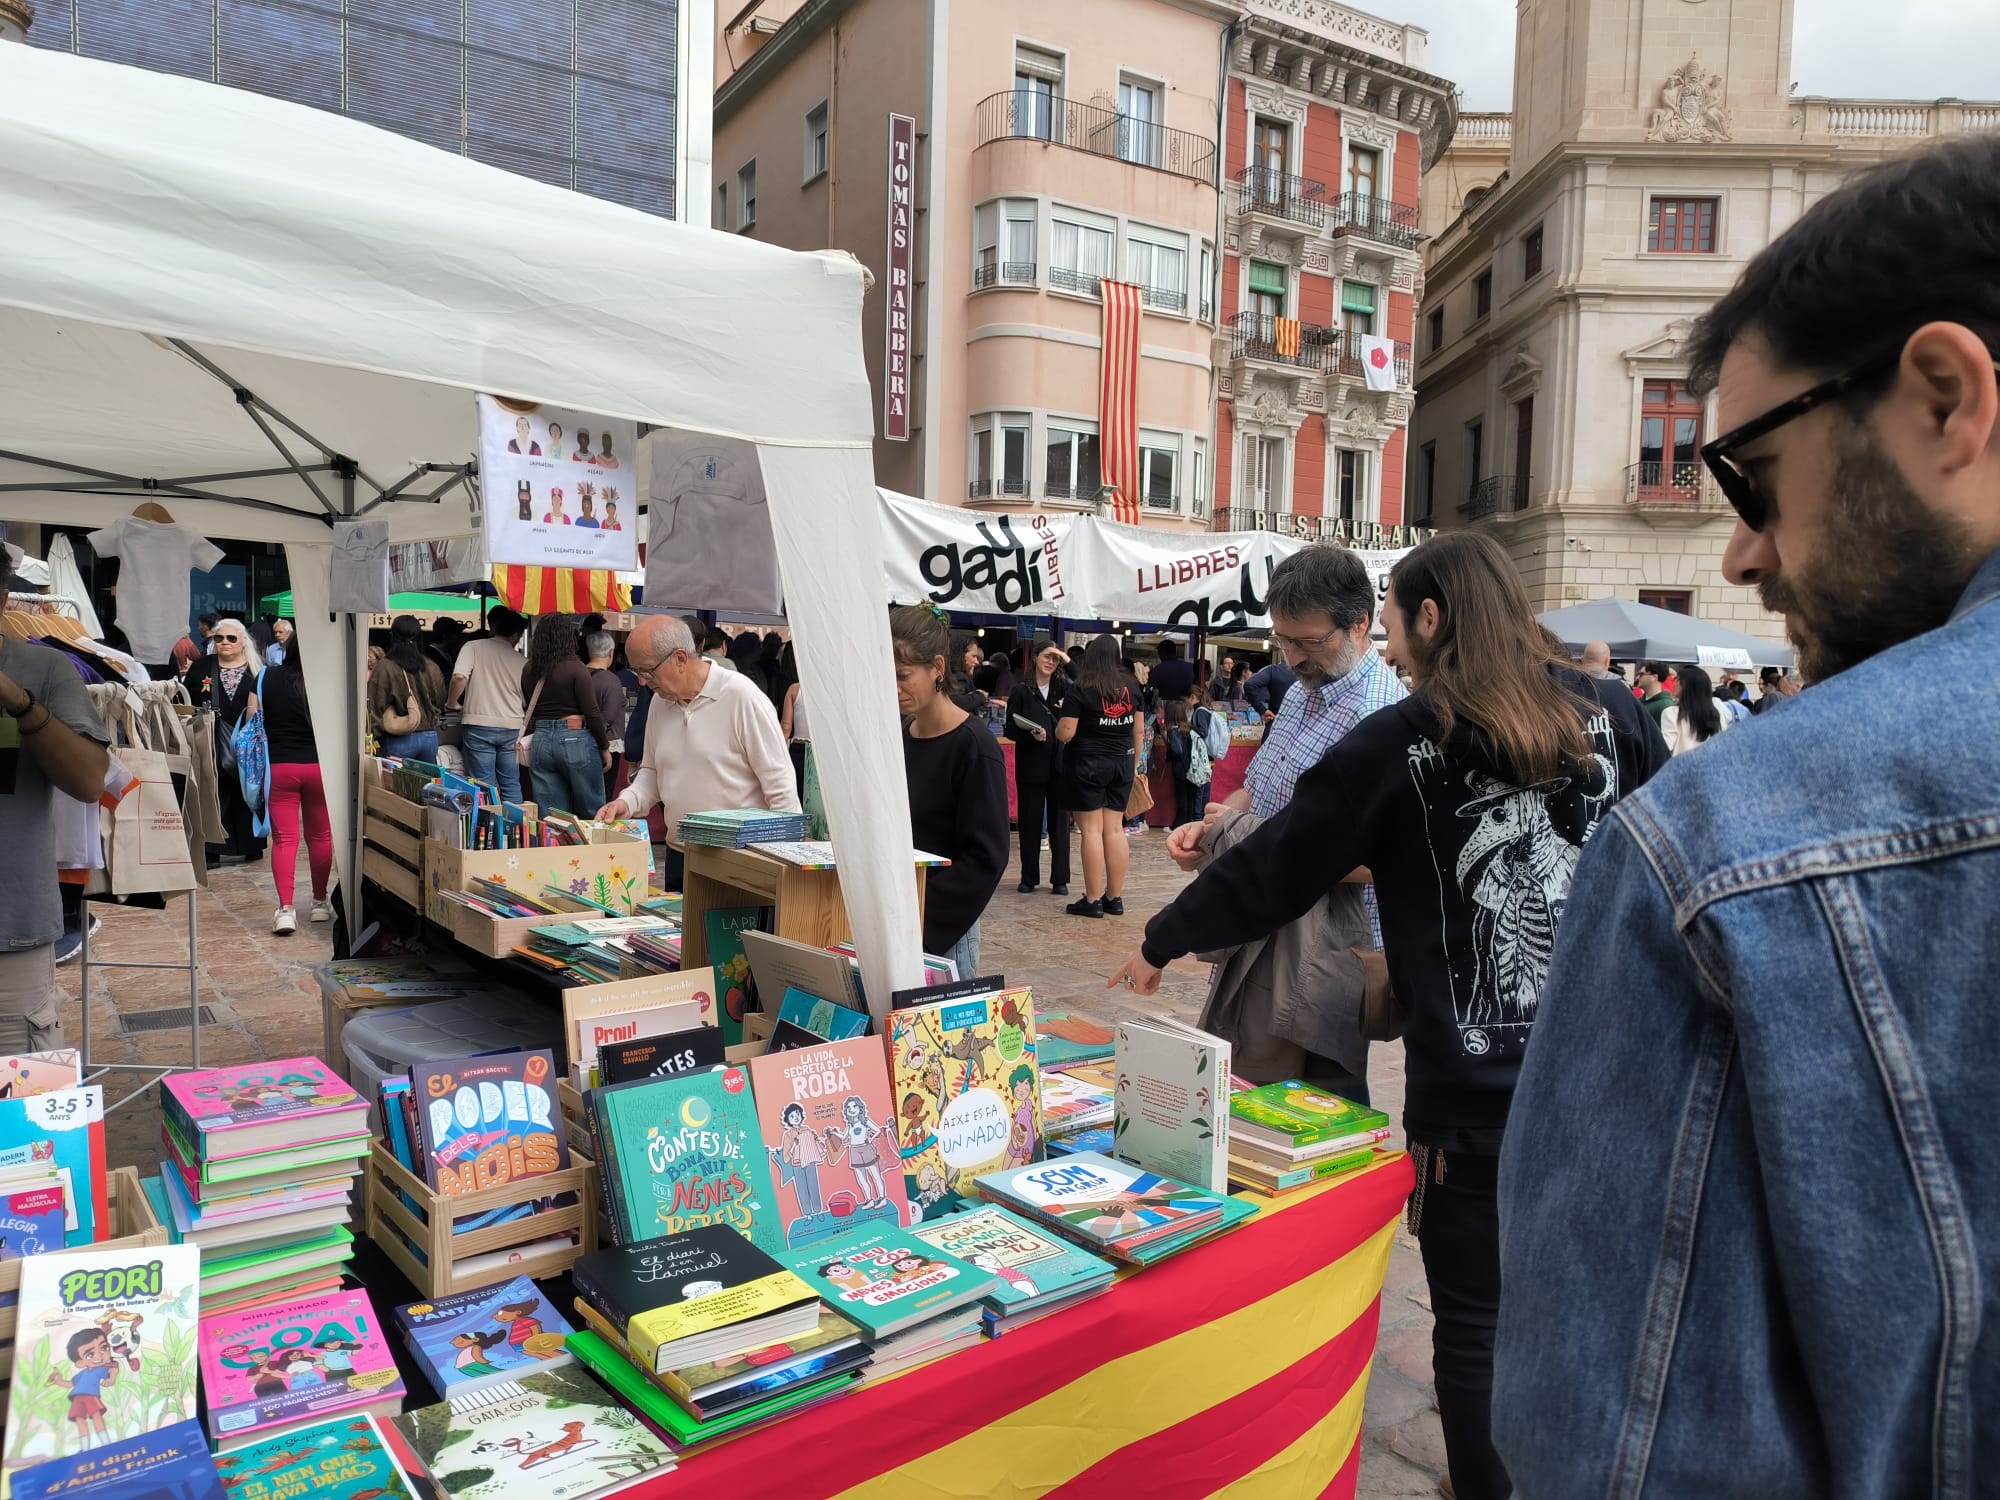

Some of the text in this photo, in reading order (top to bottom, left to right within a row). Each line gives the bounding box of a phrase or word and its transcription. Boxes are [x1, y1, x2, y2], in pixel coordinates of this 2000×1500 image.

[1253, 511, 1439, 545] RESTAURANT
[1032, 515, 1066, 600] LLIBRES
[1137, 545, 1240, 594] LLIBRES
[1099, 716, 1134, 727] MIKLAB
[722, 917, 738, 930] LA
[622, 1046, 656, 1059] FRANCESCA
[622, 1054, 650, 1065] CAVALLO
[800, 1049, 835, 1065] LA VIDA
[783, 1056, 854, 1078] SECRETA DE LA
[792, 1068, 852, 1101] ROBA
[45, 1097, 77, 1113] 3-5
[973, 1107, 983, 1121] ES
[986, 1104, 998, 1117] FA
[49, 1113, 71, 1121] ANYS
[429, 1081, 555, 1149] PODER
[943, 1118, 1007, 1154] UN NADÓ!
[441, 1132, 480, 1163] DELS
[648, 1127, 720, 1174] CONTES
[665, 1152, 727, 1183] BONA NIT
[1027, 1165, 1098, 1192] SOM
[1049, 1177, 1109, 1196] UN GRUP
[25, 1193, 49, 1203] LLETRA
[667, 1172, 746, 1216] NENES
[641, 1247, 705, 1266] El diari
[849, 1247, 886, 1264] MEU
[875, 1248, 912, 1265] COS
[1003, 1241, 1041, 1254] TU
[846, 1280, 893, 1300] MEVES
[126, 1298, 145, 1306] botes
[288, 1300, 329, 1313] TIRADO
[262, 1403, 281, 1413] 100
[468, 1408, 501, 1425] GATA
[509, 1397, 540, 1412] GOS
[76, 1446, 148, 1474] El diari
[46, 1467, 120, 1494] d'Anna
[125, 1448, 180, 1471] Frank
[244, 1453, 361, 1498] EL NEN QUE
